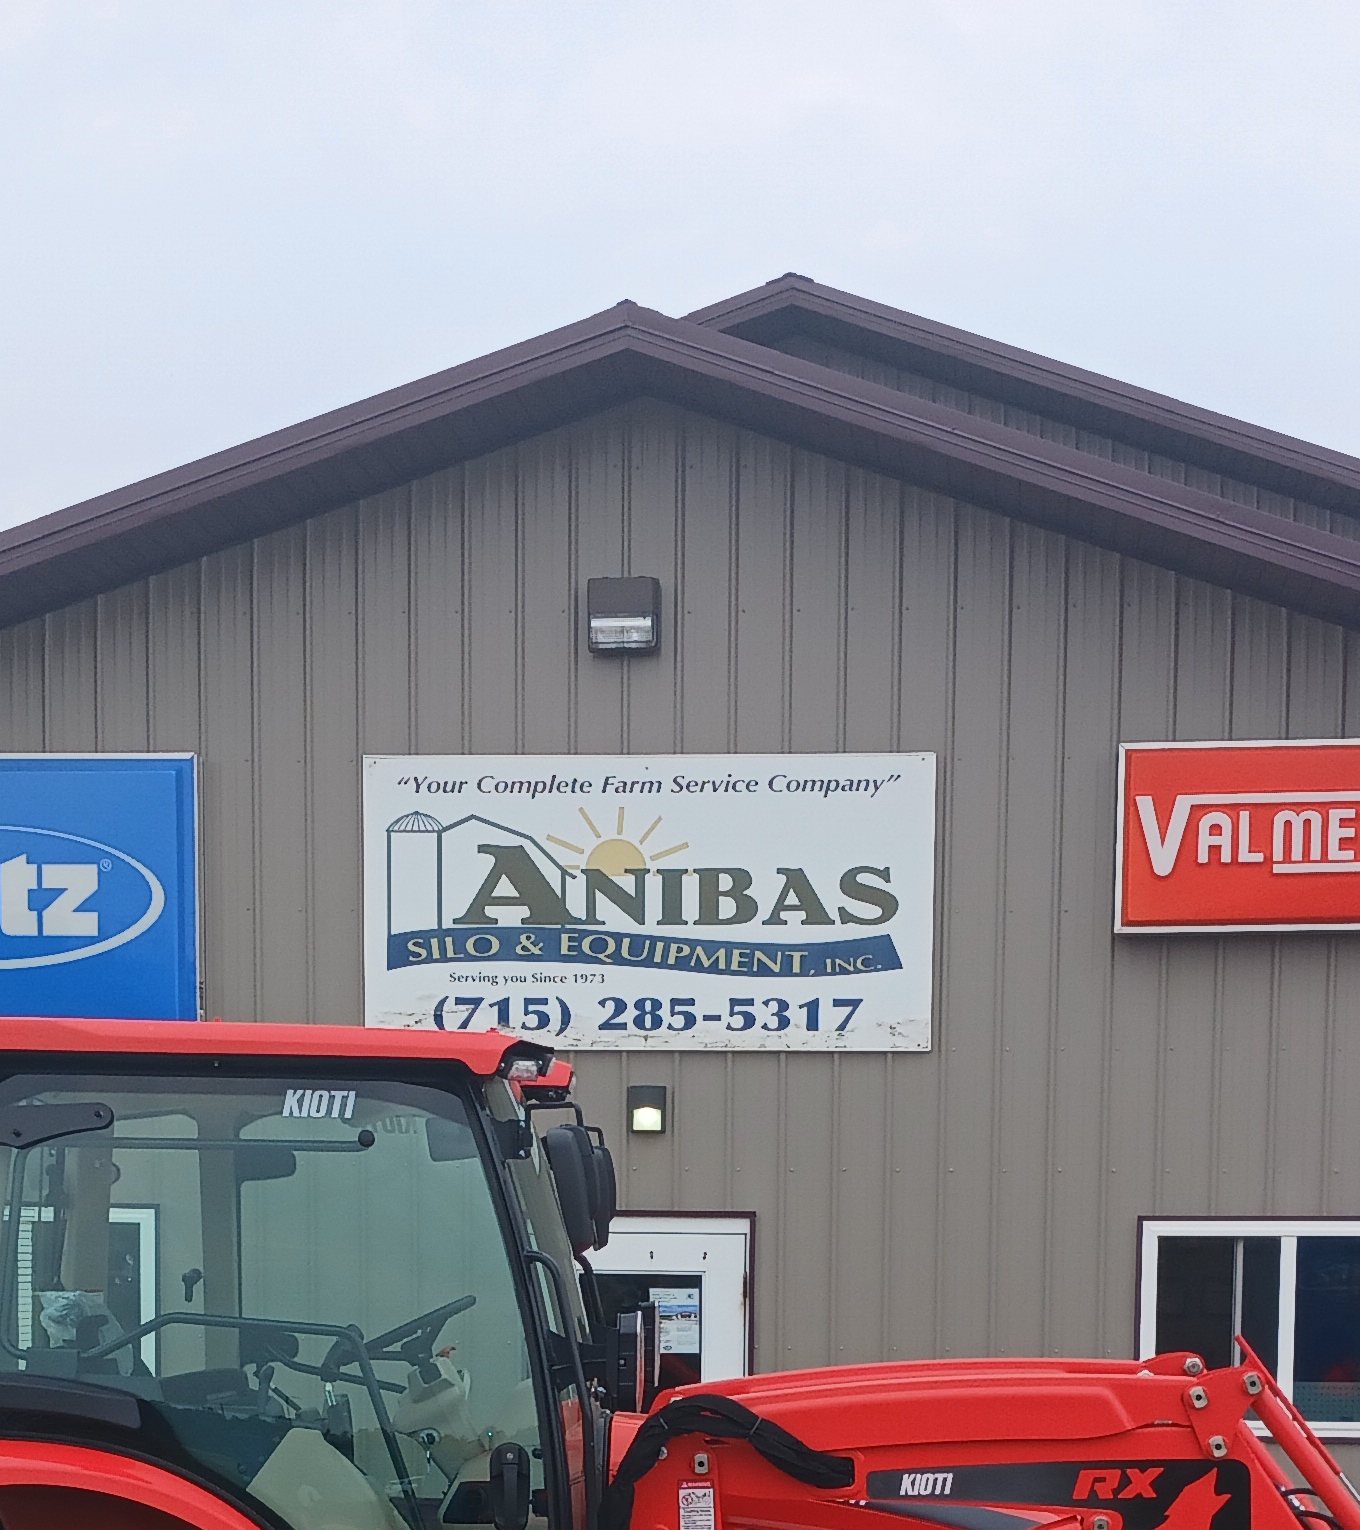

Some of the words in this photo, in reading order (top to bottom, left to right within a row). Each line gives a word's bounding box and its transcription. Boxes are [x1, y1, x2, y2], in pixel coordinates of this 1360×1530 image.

[476, 775, 592, 799] Complete
[601, 775, 662, 794] Farm
[671, 773, 758, 793] Service
[452, 844, 899, 926] ANIBAS
[406, 934, 500, 962] SILO
[515, 933, 544, 956] &
[560, 933, 816, 976] EQUIPMENT,
[825, 955, 882, 973] INC.
[449, 971, 499, 986] Serving
[503, 974, 527, 986] you
[531, 972, 568, 984] Since
[572, 973, 605, 985] 1973
[433, 996, 572, 1037] (715)
[597, 996, 864, 1032] 285-5317
[282, 1089, 356, 1119] KIOTI
[899, 1472, 953, 1496] KIOTI
[1072, 1467, 1165, 1500] RX
